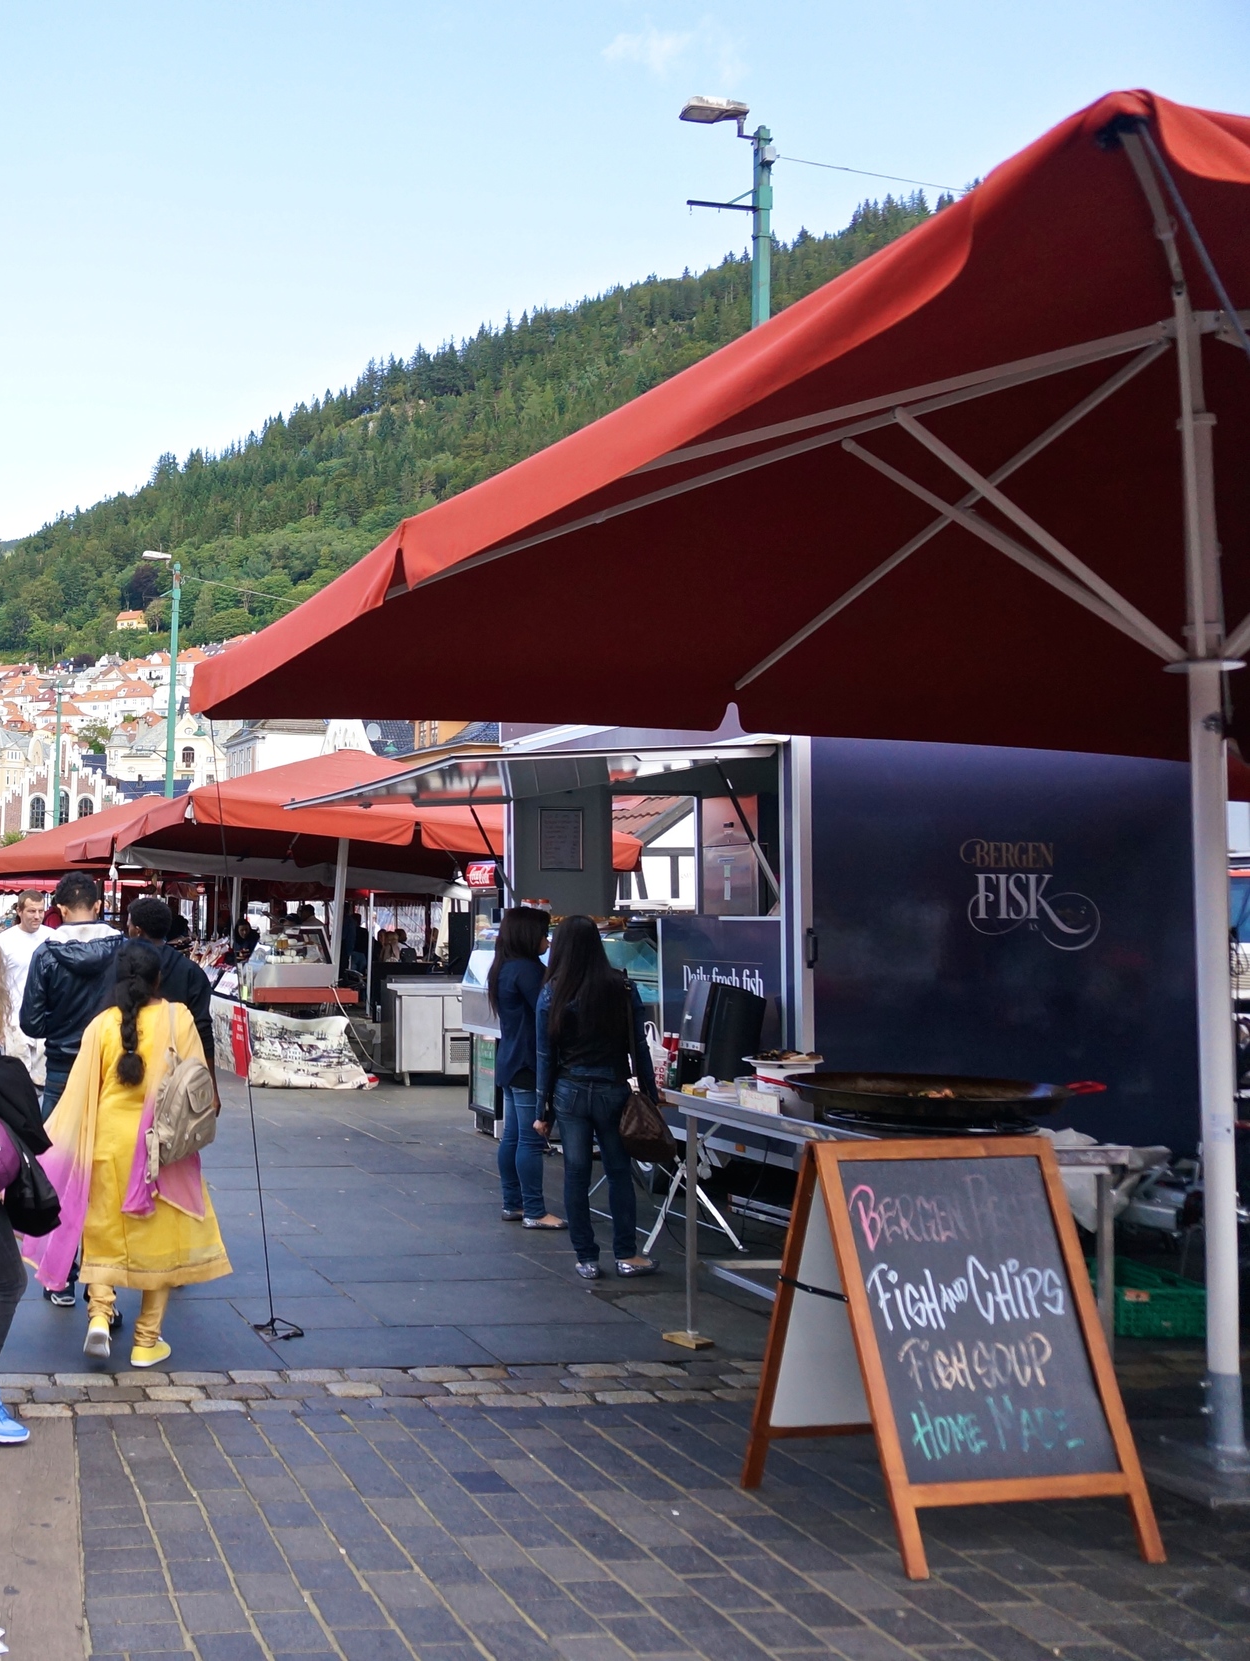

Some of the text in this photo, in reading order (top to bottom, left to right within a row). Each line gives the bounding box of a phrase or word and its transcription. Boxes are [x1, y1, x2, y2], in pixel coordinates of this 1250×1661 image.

[959, 838, 1054, 868] BERGEN
[742, 968, 765, 998] fish
[971, 1331, 1053, 1390] SOUP
[910, 1399, 989, 1461] HOME
